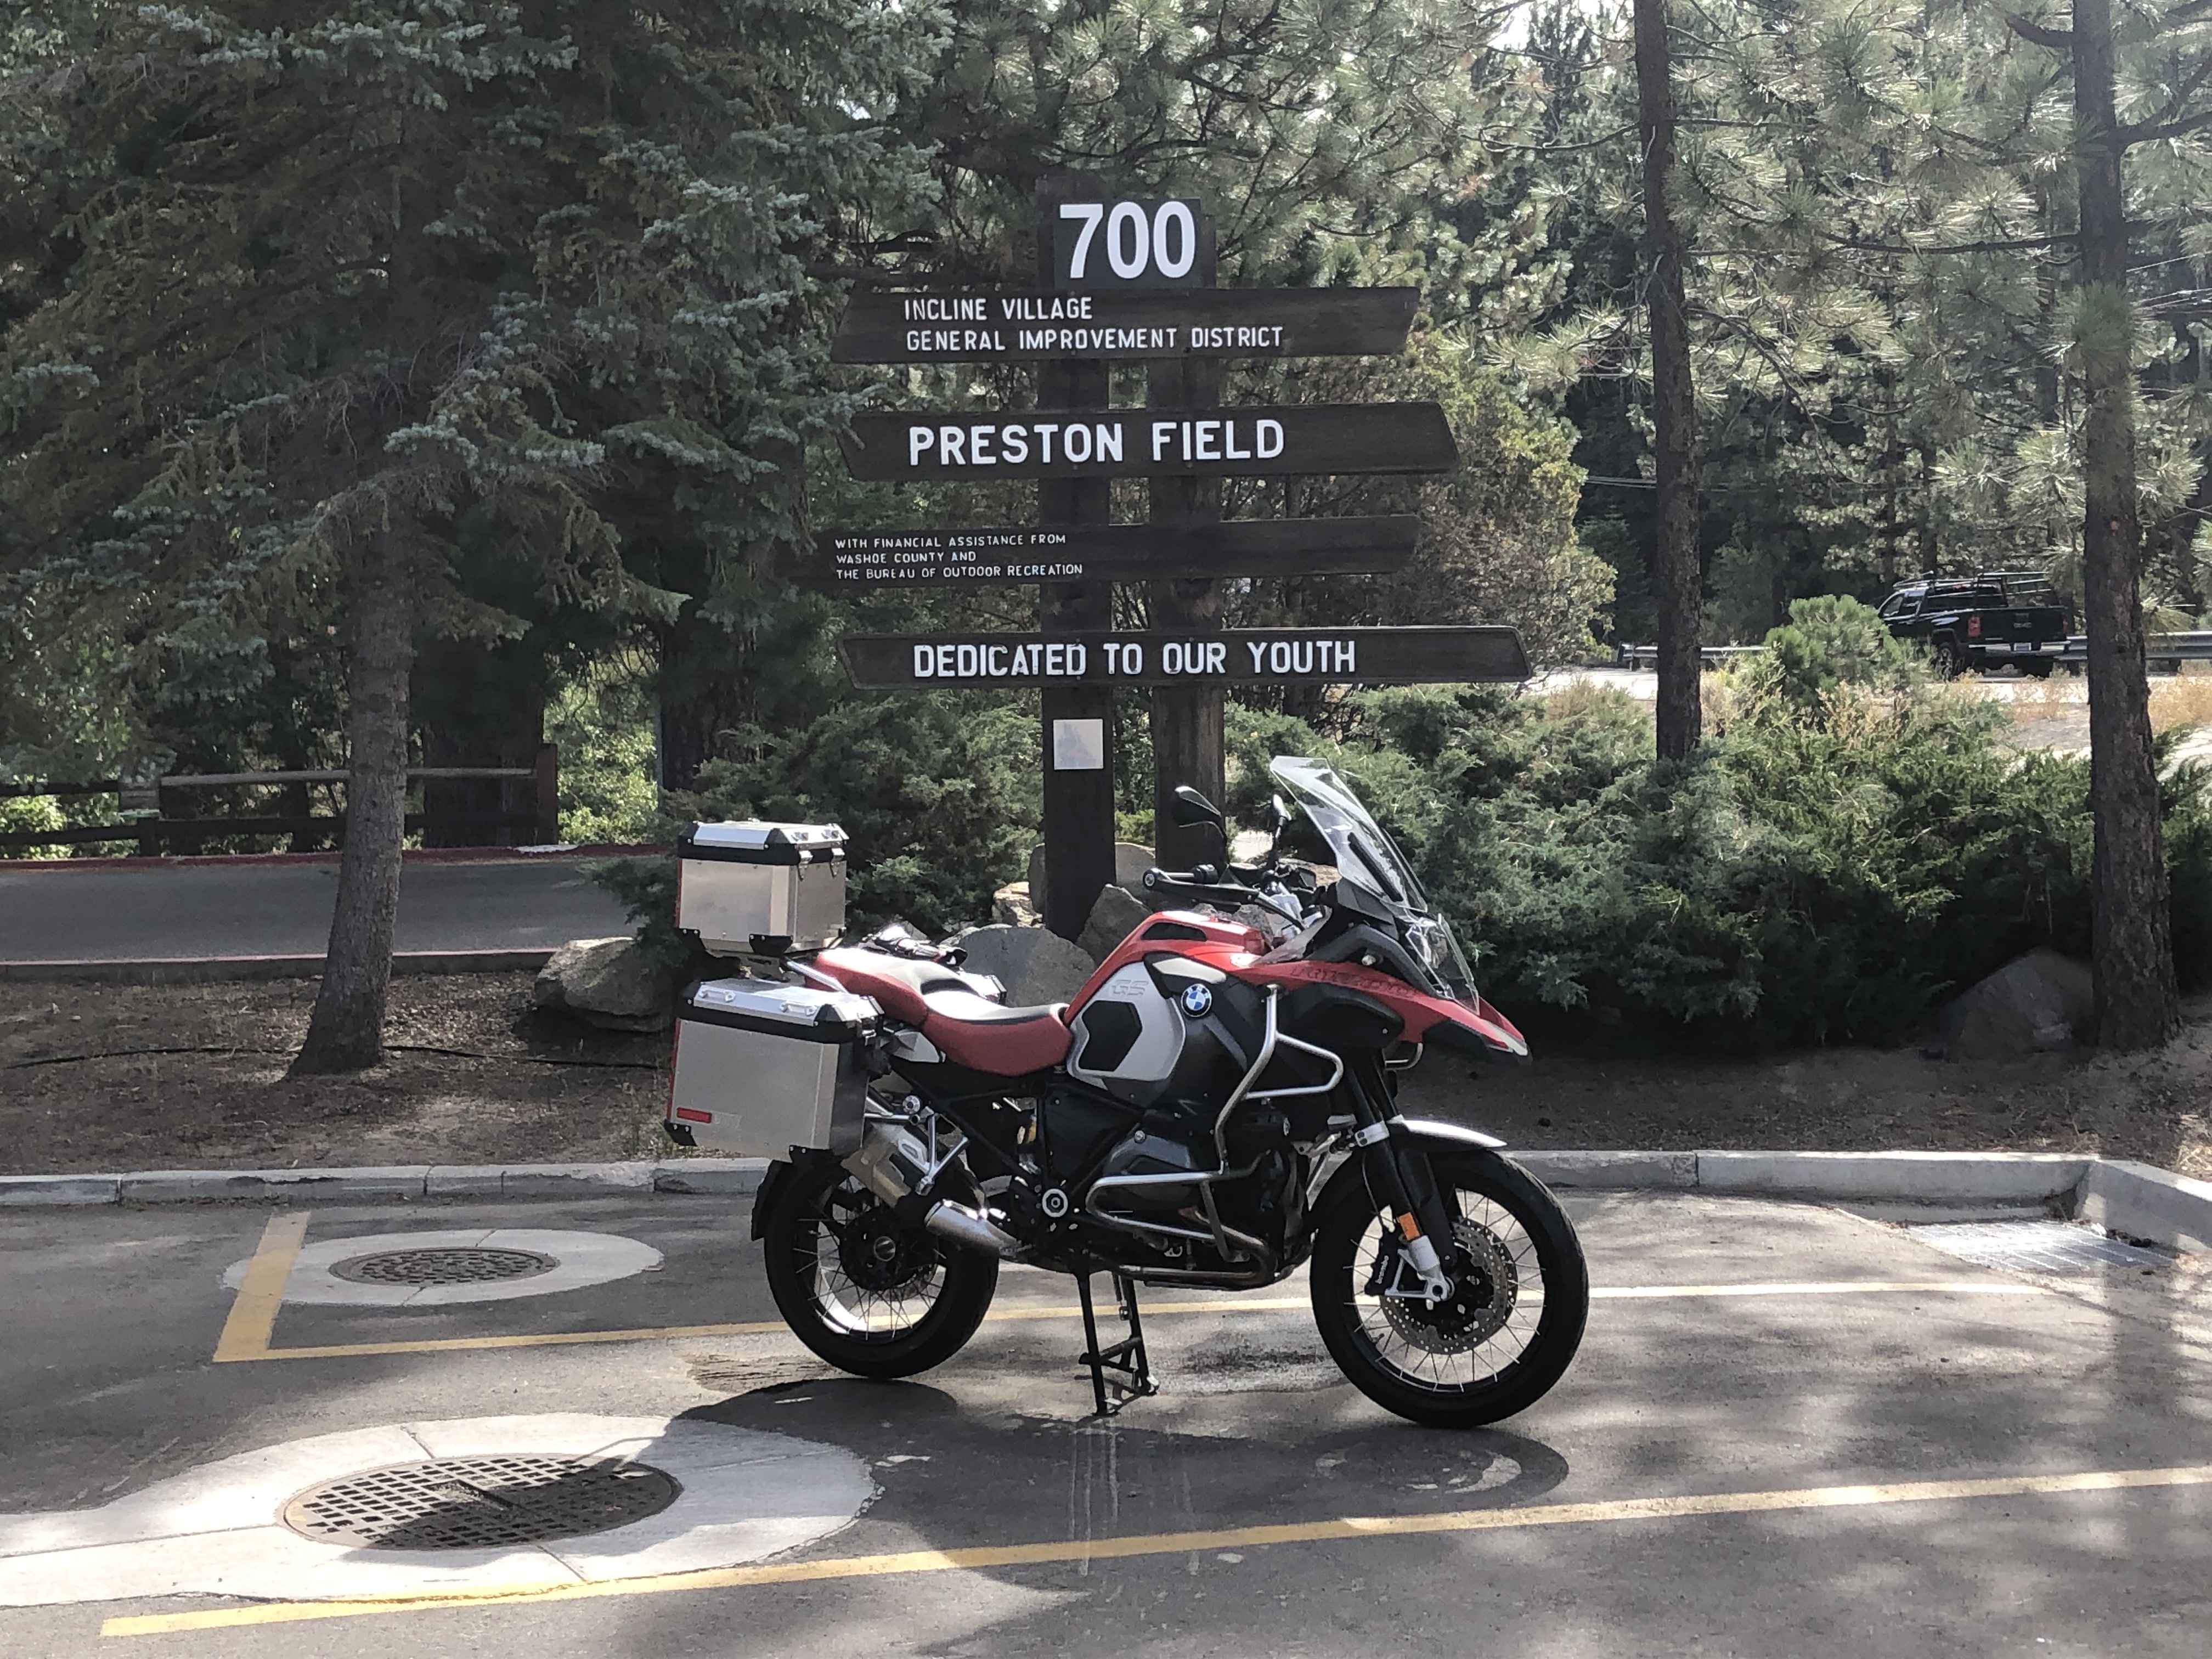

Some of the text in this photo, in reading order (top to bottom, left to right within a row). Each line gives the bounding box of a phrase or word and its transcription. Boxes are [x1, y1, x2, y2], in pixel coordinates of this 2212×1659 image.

[1060, 201, 1195, 279] 700
[905, 297, 1092, 320] INCLINE VILLAGE
[907, 326, 1283, 351] GENERAL IMPROVEMENT DISTRICT
[909, 419, 1284, 465] PRESTON FIELD
[835, 534, 1066, 549] WITH FINANCIAL ASSISTANCE FROM
[836, 551, 976, 564] WASHOE COUNTY AND
[836, 563, 1082, 579] THE BUREAU OF OUTDOOR RECREATION
[914, 640, 1355, 677] DEDICATED TO OUR YOUTH
